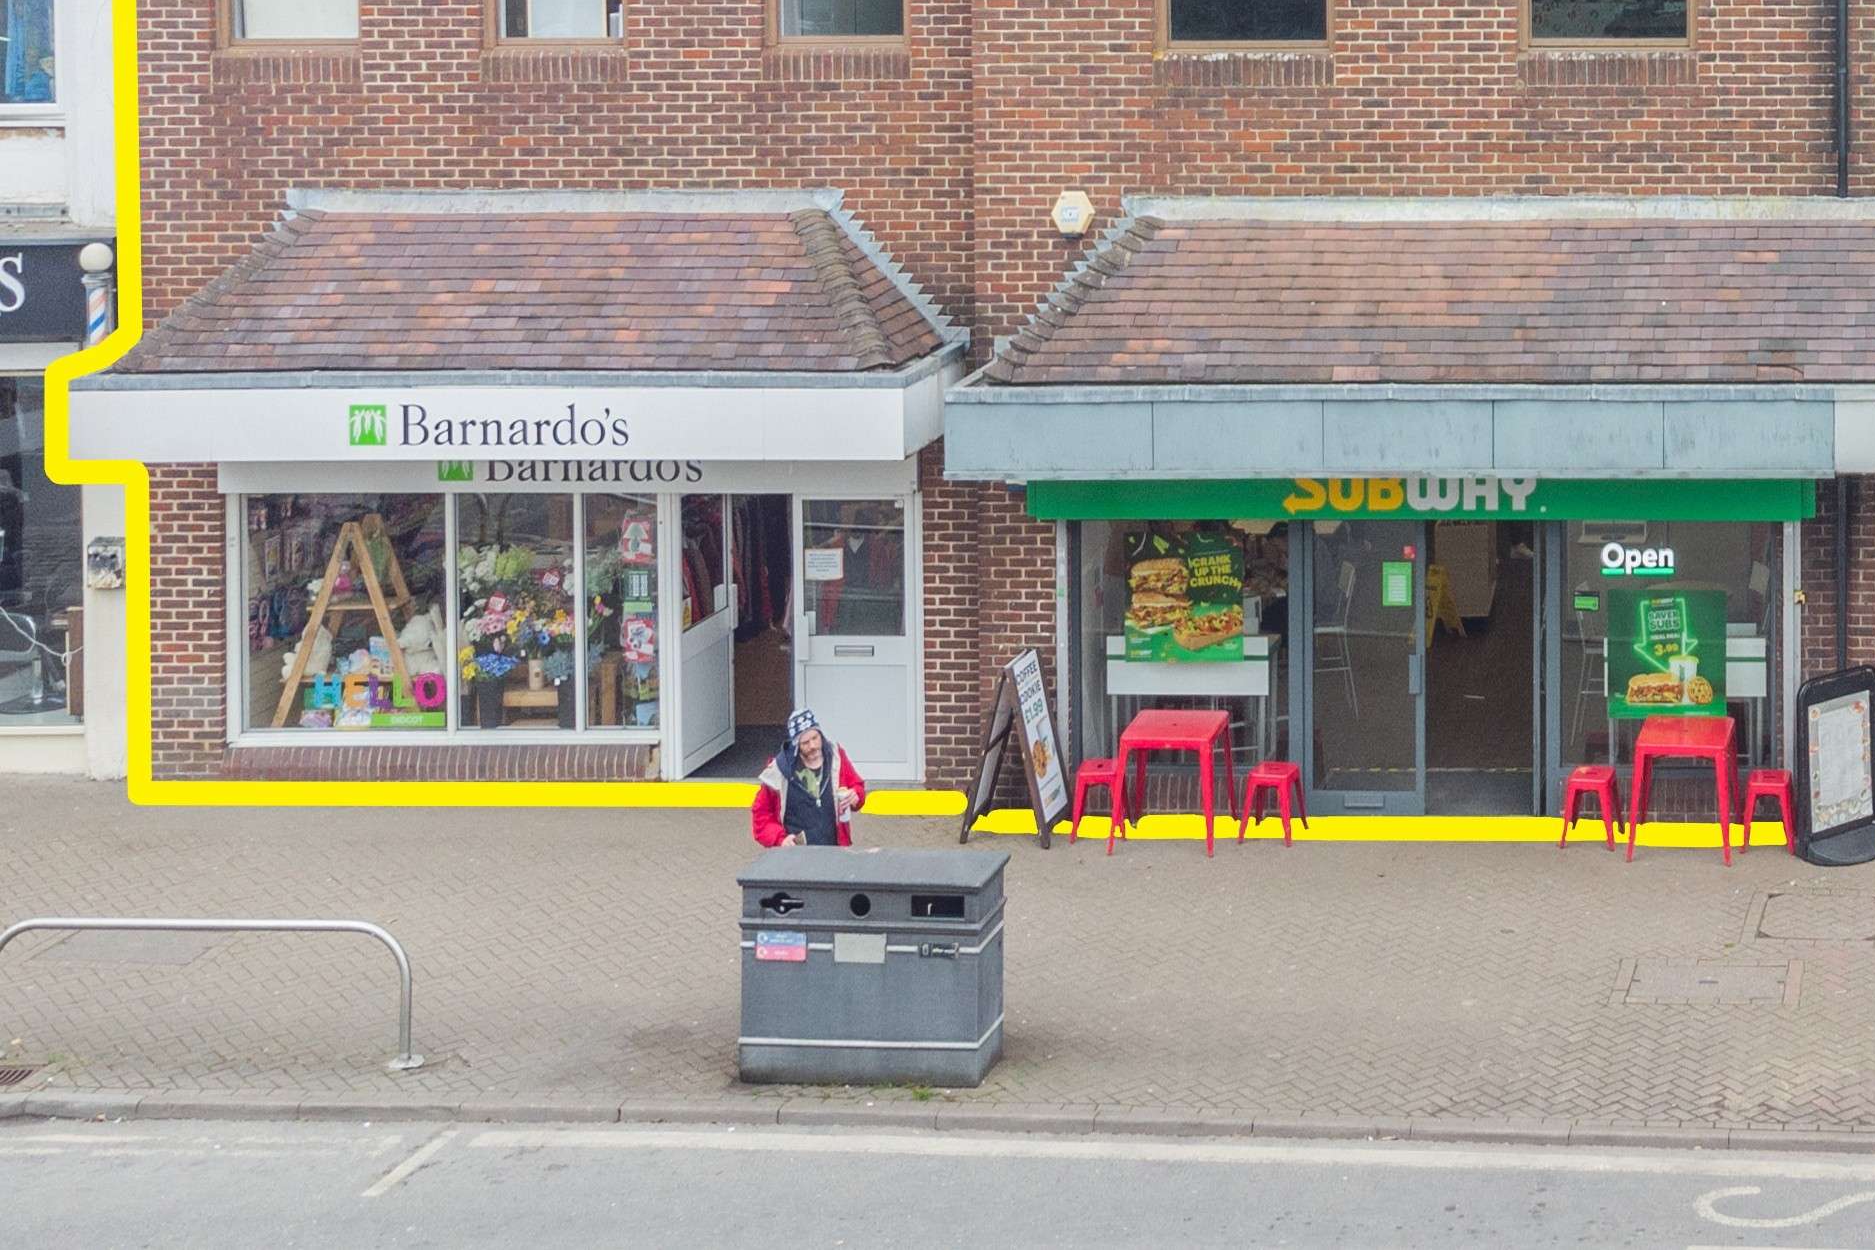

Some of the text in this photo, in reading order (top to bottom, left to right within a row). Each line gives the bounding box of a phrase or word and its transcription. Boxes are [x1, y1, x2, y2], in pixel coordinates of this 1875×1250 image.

[399, 403, 630, 447] Barnardo's
[485, 460, 703, 482] Barnardos
[1283, 478, 1537, 515] SUBWAY
[1192, 554, 1231, 568] CRANK
[1194, 564, 1231, 577] UP THE
[1602, 542, 1675, 575] Open
[1016, 660, 1038, 686] COFFEE
[314, 672, 447, 710] HELLO
[1020, 679, 1042, 705] COOKIE
[1025, 698, 1044, 725] £1.99
